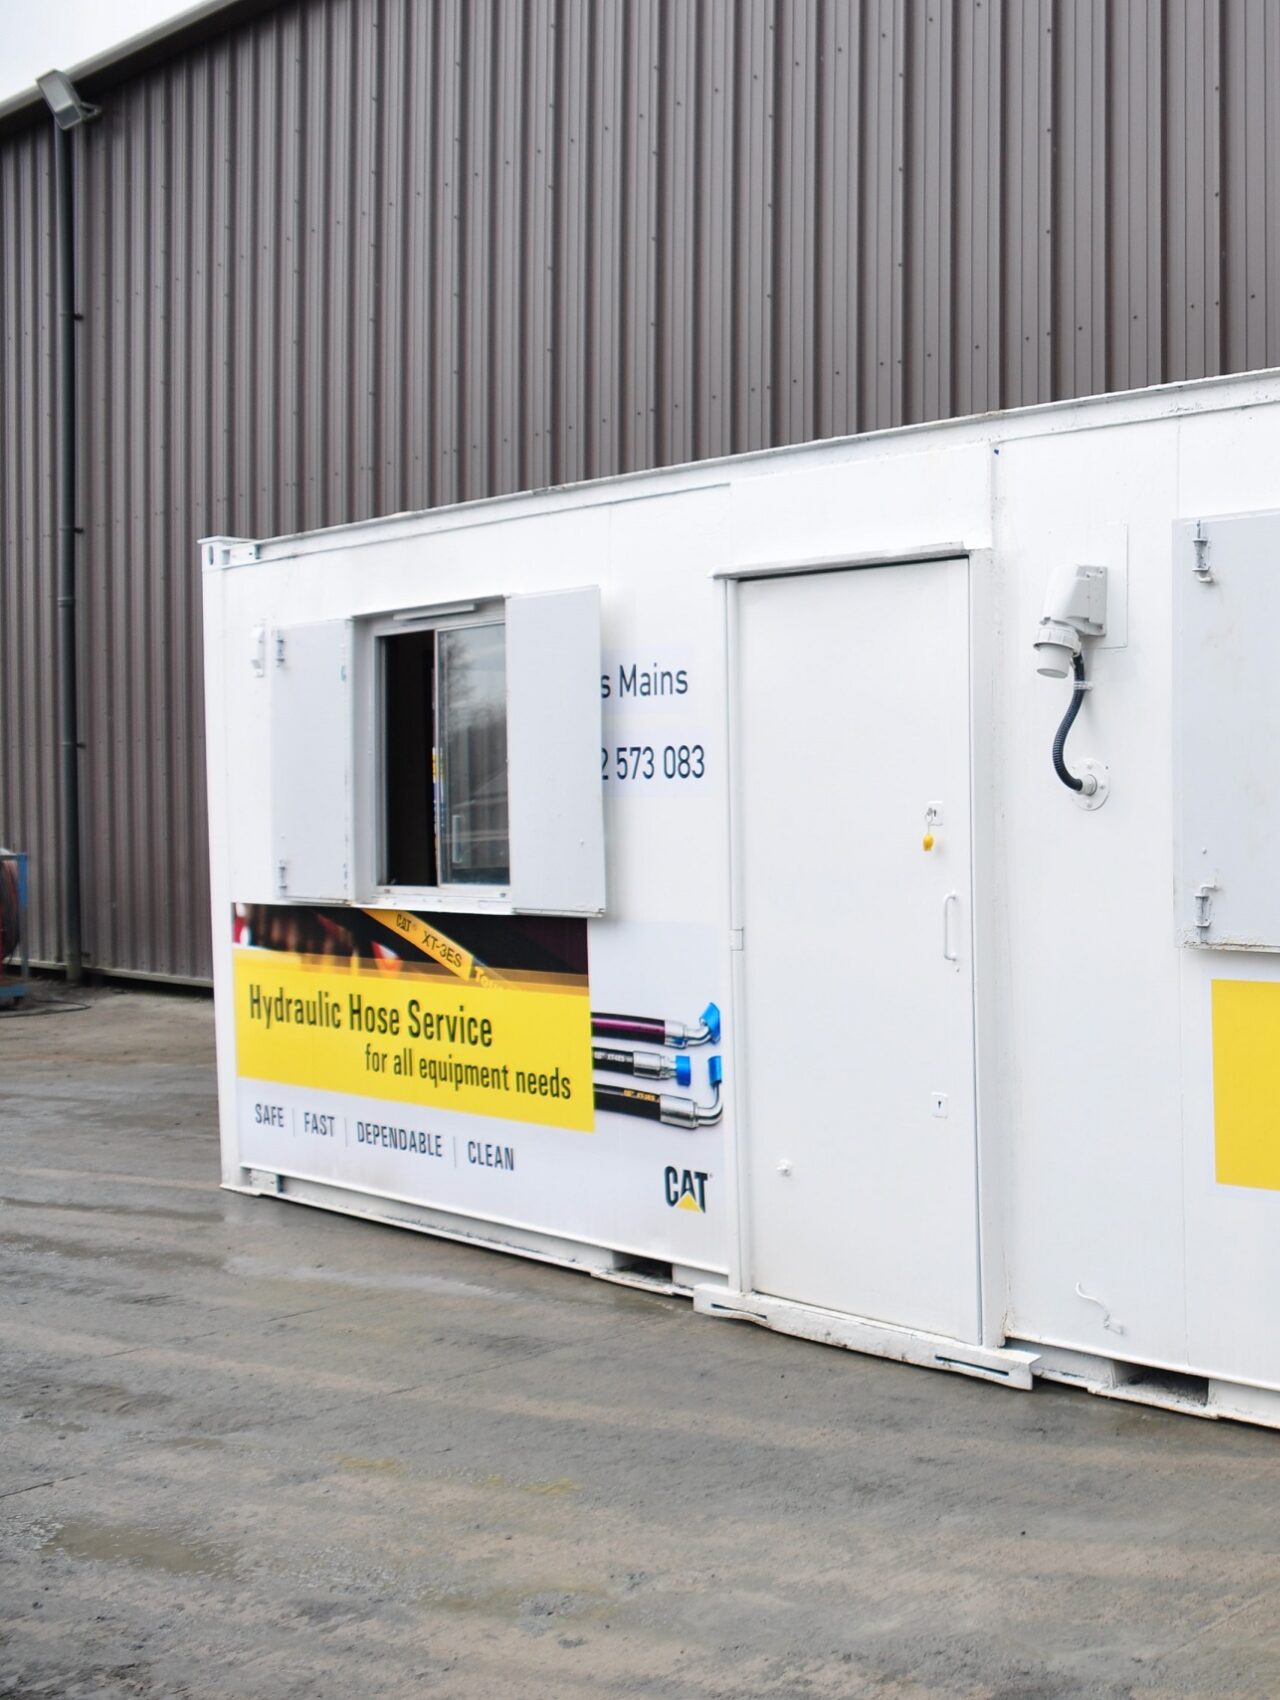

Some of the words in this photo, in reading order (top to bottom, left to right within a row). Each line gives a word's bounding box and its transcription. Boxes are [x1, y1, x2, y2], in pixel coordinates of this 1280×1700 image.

[619, 662, 688, 698] Mains
[616, 746, 655, 780] 573
[663, 744, 705, 779] 083
[396, 913, 412, 932] CAT
[421, 931, 463, 968] XT-3ES
[249, 984, 341, 1029] Hydraulic
[348, 994, 400, 1036] Hose
[407, 999, 493, 1047] Service
[365, 1043, 388, 1073] for
[393, 1048, 413, 1077] all
[418, 1055, 510, 1092] equipment
[515, 1067, 572, 1101] needs
[255, 1104, 284, 1128] SAFE
[304, 1112, 336, 1138] FAST
[356, 1121, 443, 1158] DEPENDABLE
[467, 1140, 515, 1172] CLEAN
[664, 1166, 709, 1213] CAT
